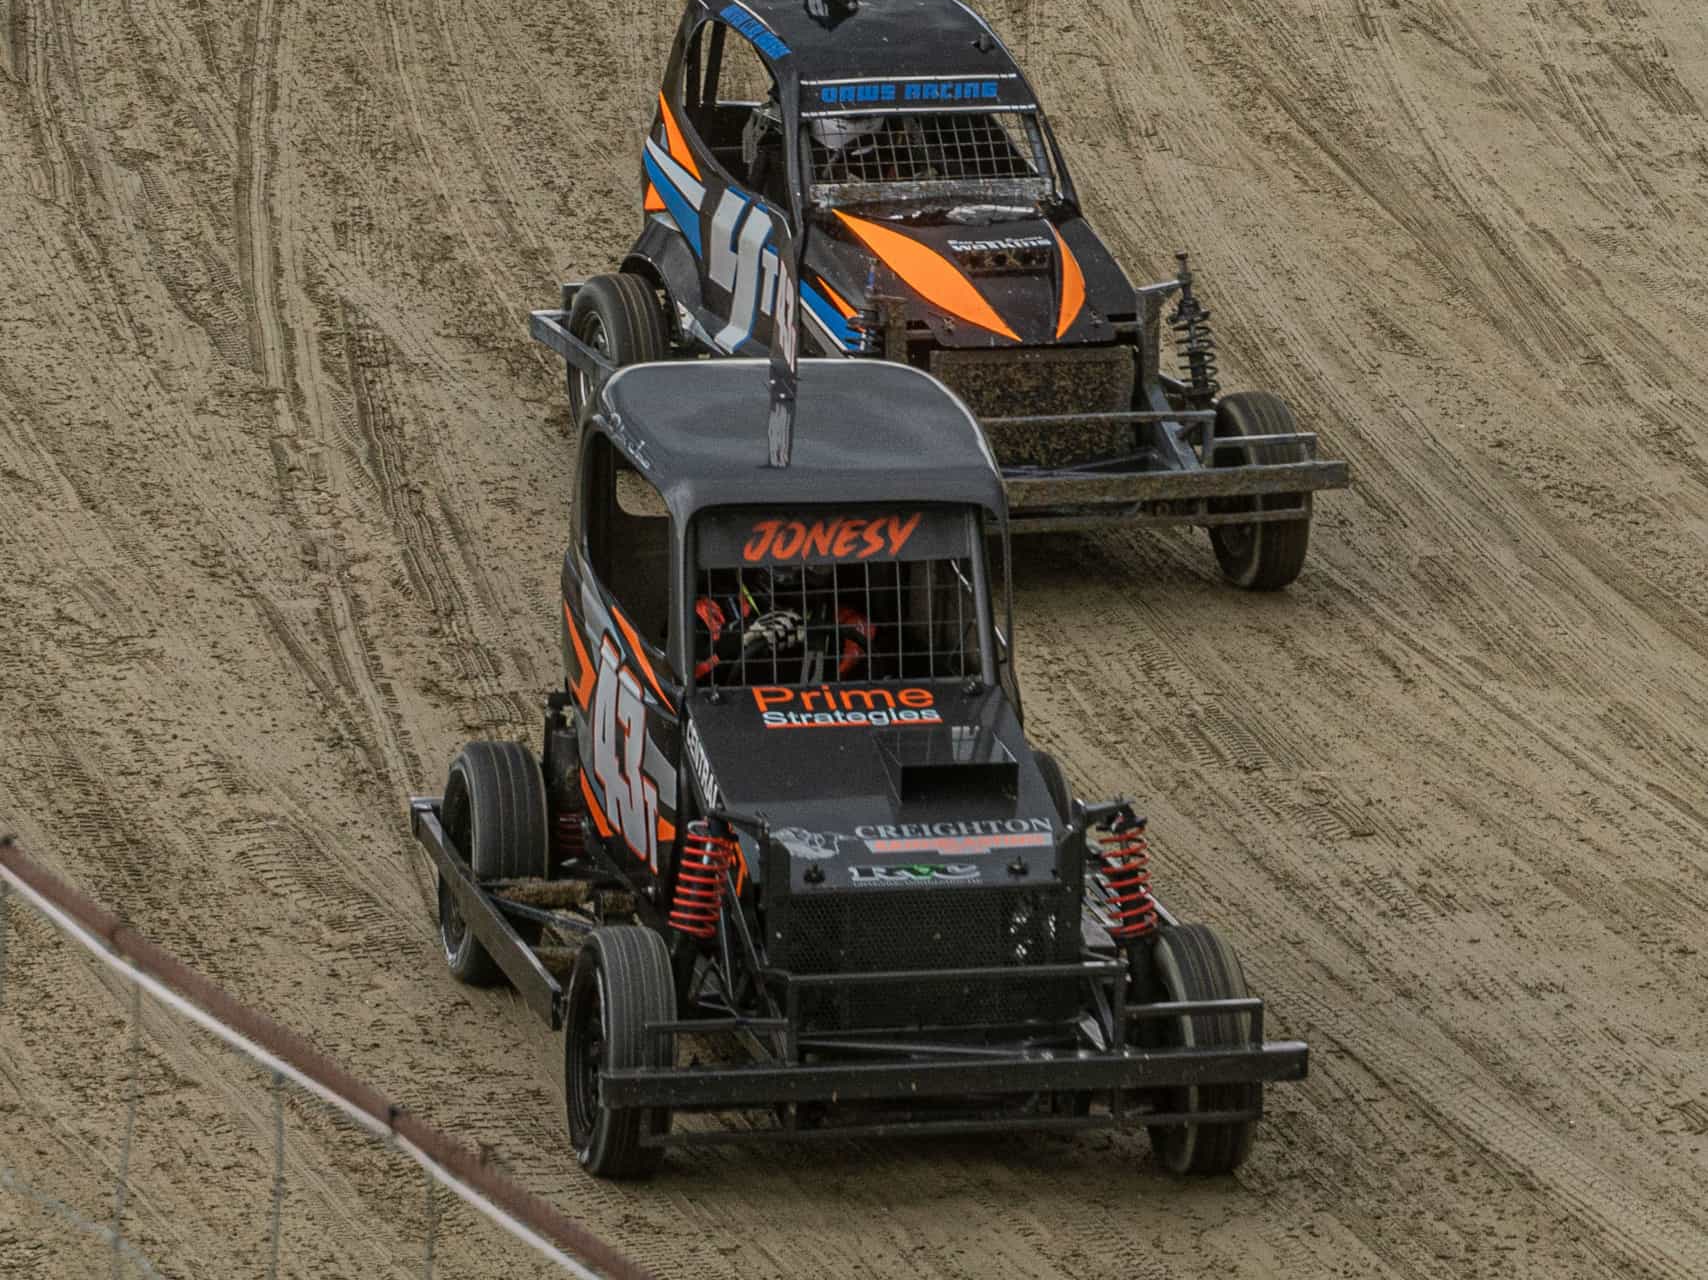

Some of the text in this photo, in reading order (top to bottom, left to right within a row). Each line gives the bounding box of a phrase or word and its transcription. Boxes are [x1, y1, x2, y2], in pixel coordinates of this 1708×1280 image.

[820, 81, 999, 104] DAWS RACING
[743, 512, 922, 561] JONESY
[751, 684, 935, 713] Prime
[762, 708, 941, 727] Strategies
[855, 816, 1052, 840] CREIGHTON
